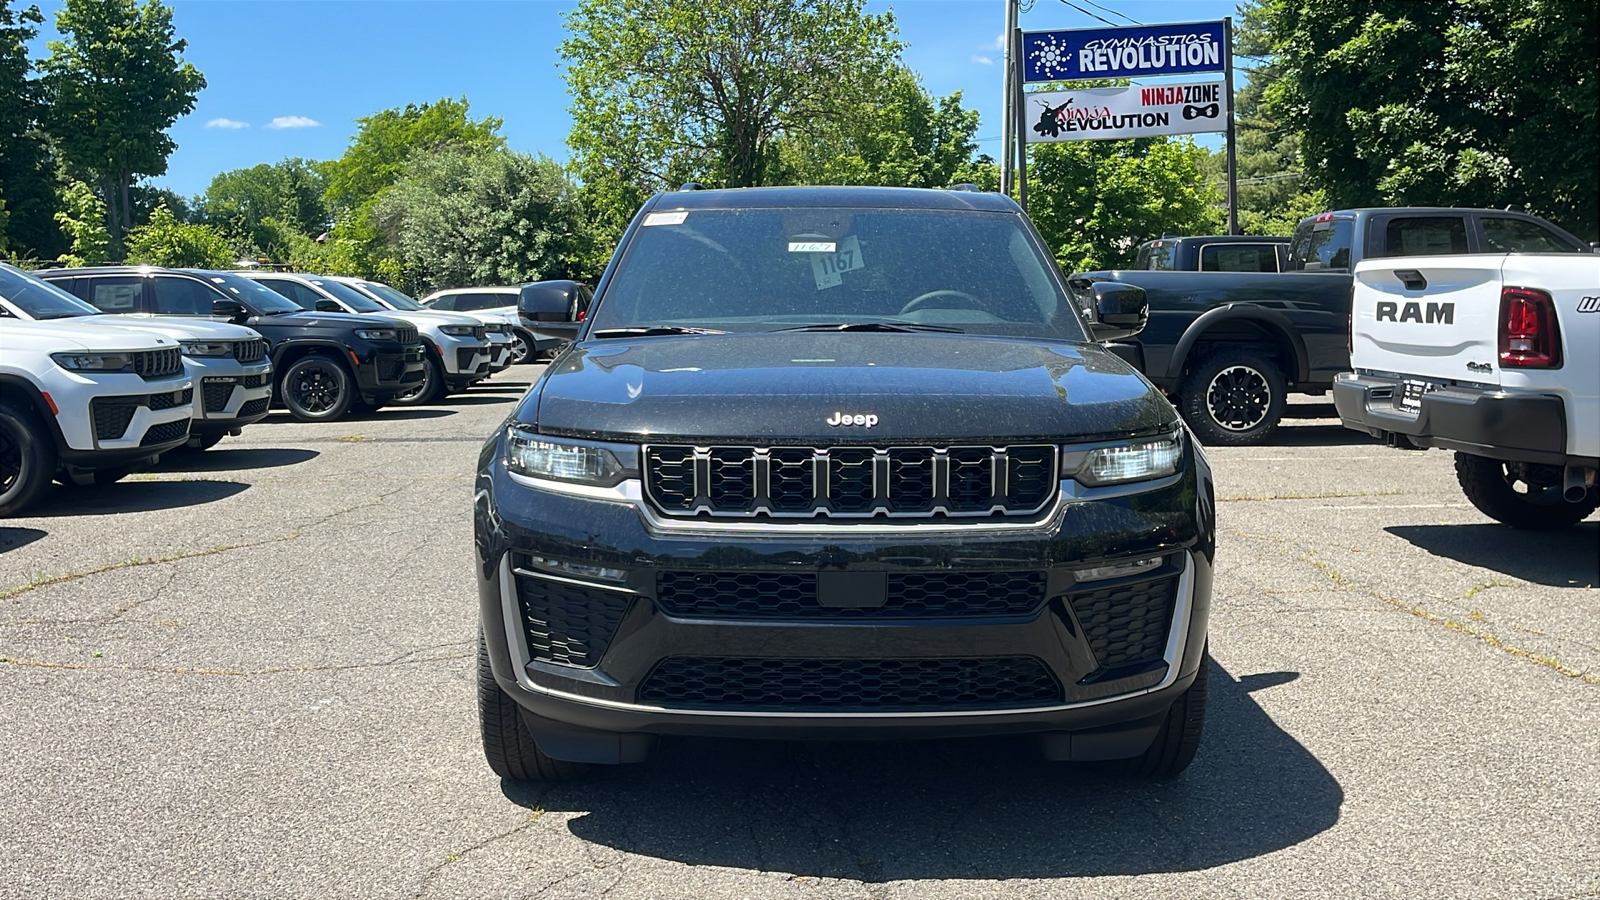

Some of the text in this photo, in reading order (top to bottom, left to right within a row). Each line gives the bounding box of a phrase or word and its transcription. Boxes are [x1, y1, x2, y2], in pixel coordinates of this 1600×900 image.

[1084, 33, 1212, 51] GYMNASTICS
[1079, 42, 1219, 72] REVOLUTION
[1141, 84, 1219, 106] NINJAZONE
[1056, 112, 1169, 132] REVOLUTION
[793, 243, 831, 252] 1167
[820, 249, 854, 275] 1167
[1376, 301, 1455, 325] RAM
[1576, 296, 1600, 313] W
[826, 411, 879, 428] Jeep
